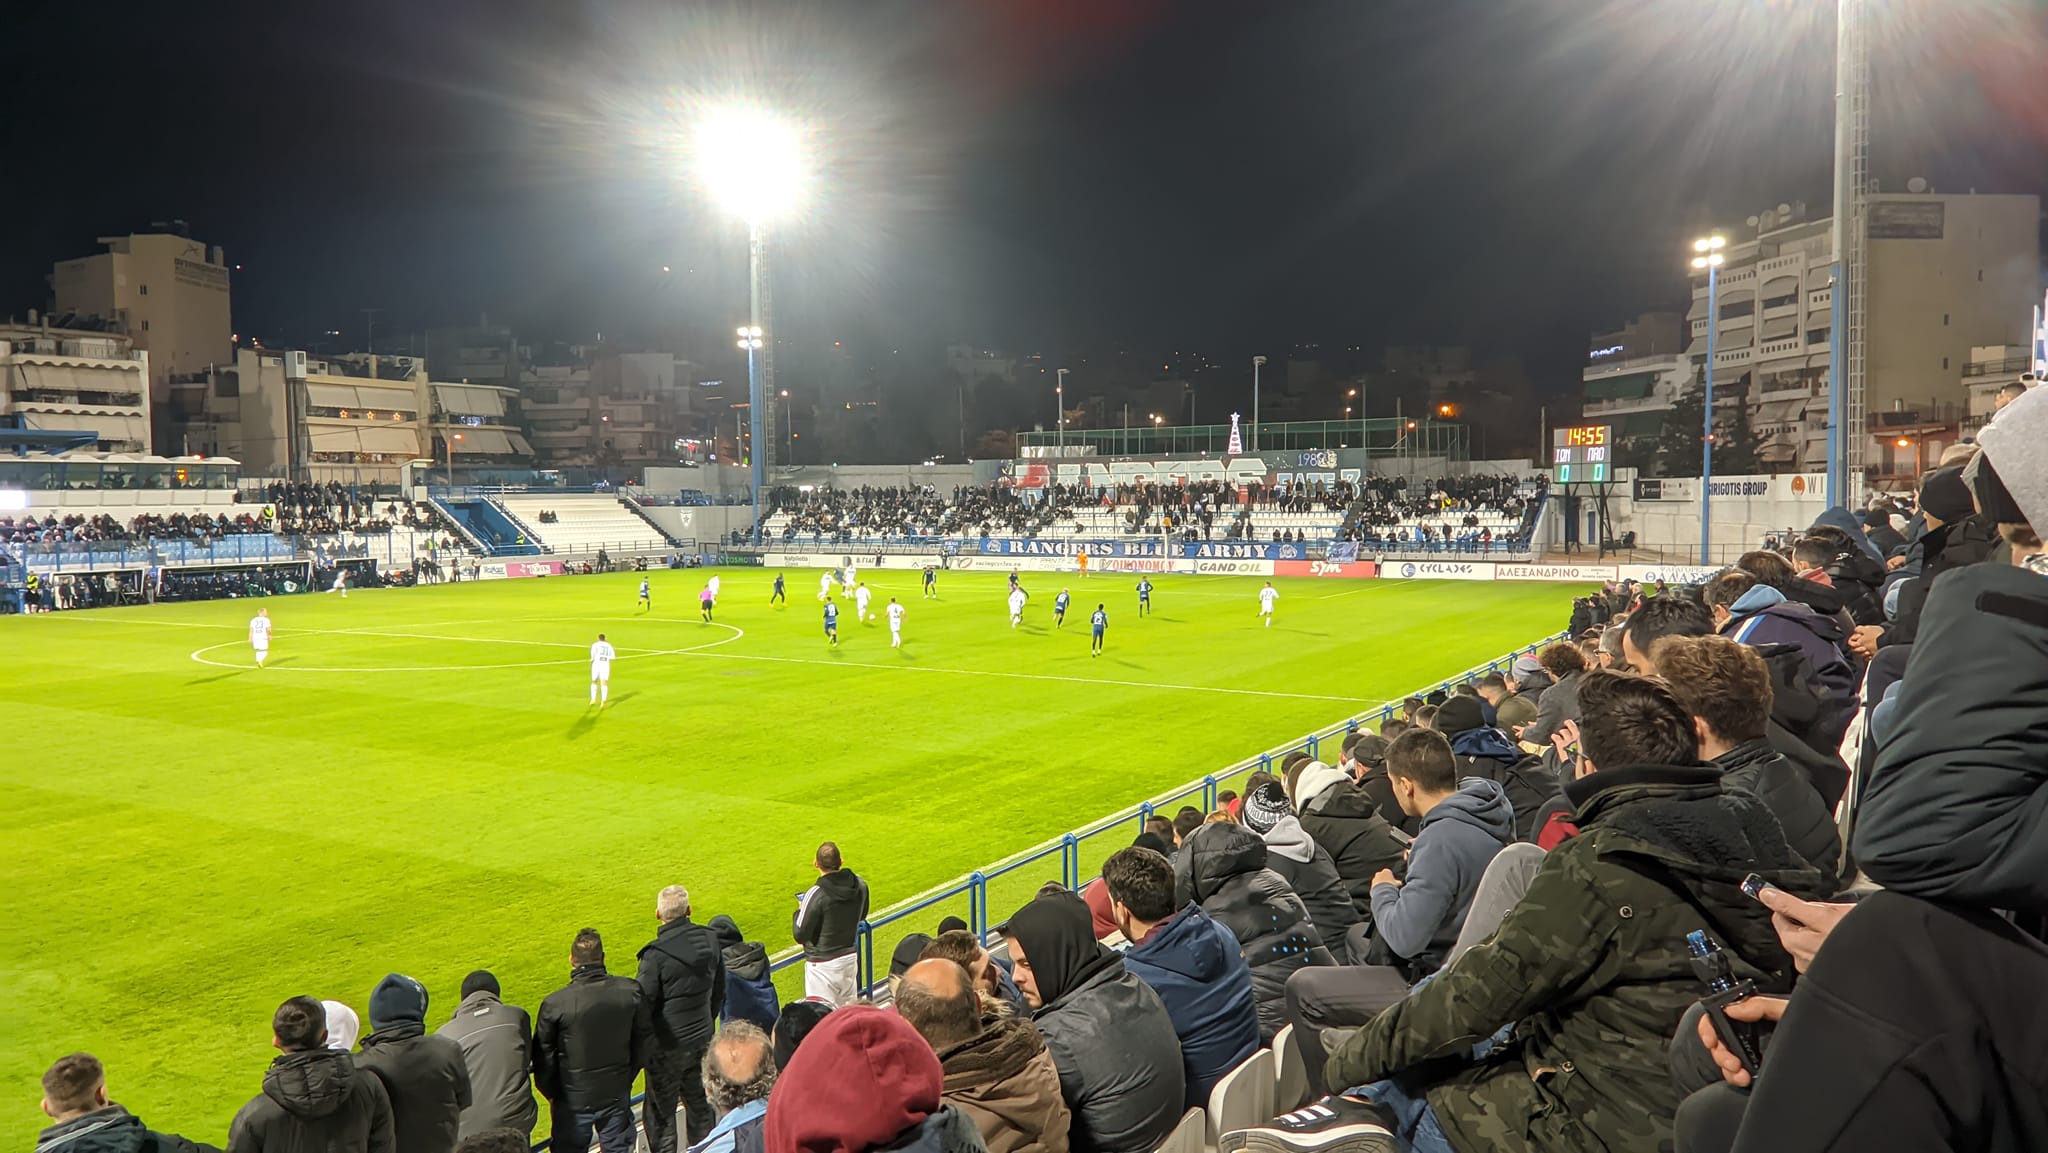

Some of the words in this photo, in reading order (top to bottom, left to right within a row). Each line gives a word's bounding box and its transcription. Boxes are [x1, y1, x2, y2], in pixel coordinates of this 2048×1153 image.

[1568, 426, 1605, 447] 14:55
[1559, 464, 1570, 482] 0
[1593, 463, 1604, 482] 0
[1743, 482, 1768, 496] GROUP
[1009, 540, 1114, 556] RANGERS
[1124, 542, 1185, 557] BLUE
[1196, 544, 1270, 558] ARMY
[757, 556, 764, 564] TV
[1199, 562, 1237, 572] GAND
[1238, 563, 1262, 572] OIL
[1498, 566, 1580, 578] ΑΛΕΞΑΝΔΡΙΝΟ
